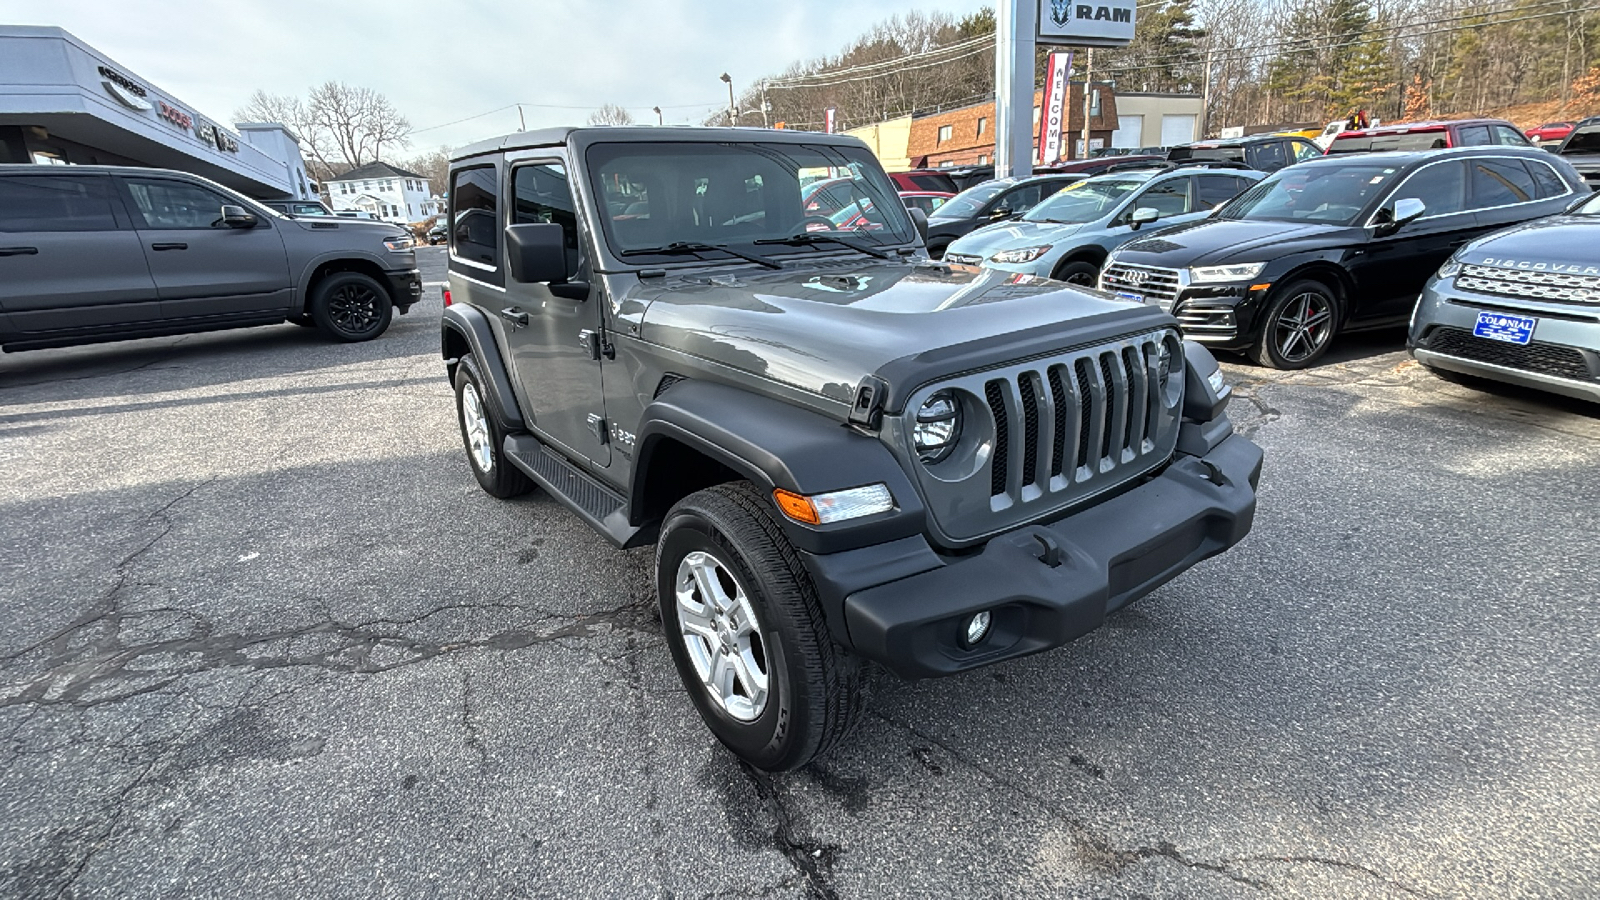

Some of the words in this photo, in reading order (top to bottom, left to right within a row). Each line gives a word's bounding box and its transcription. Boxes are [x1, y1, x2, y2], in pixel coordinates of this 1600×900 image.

[1076, 5, 1131, 23] RAM
[1048, 67, 1064, 150] WELCOME
[1483, 257, 1599, 274] DISCOVER
